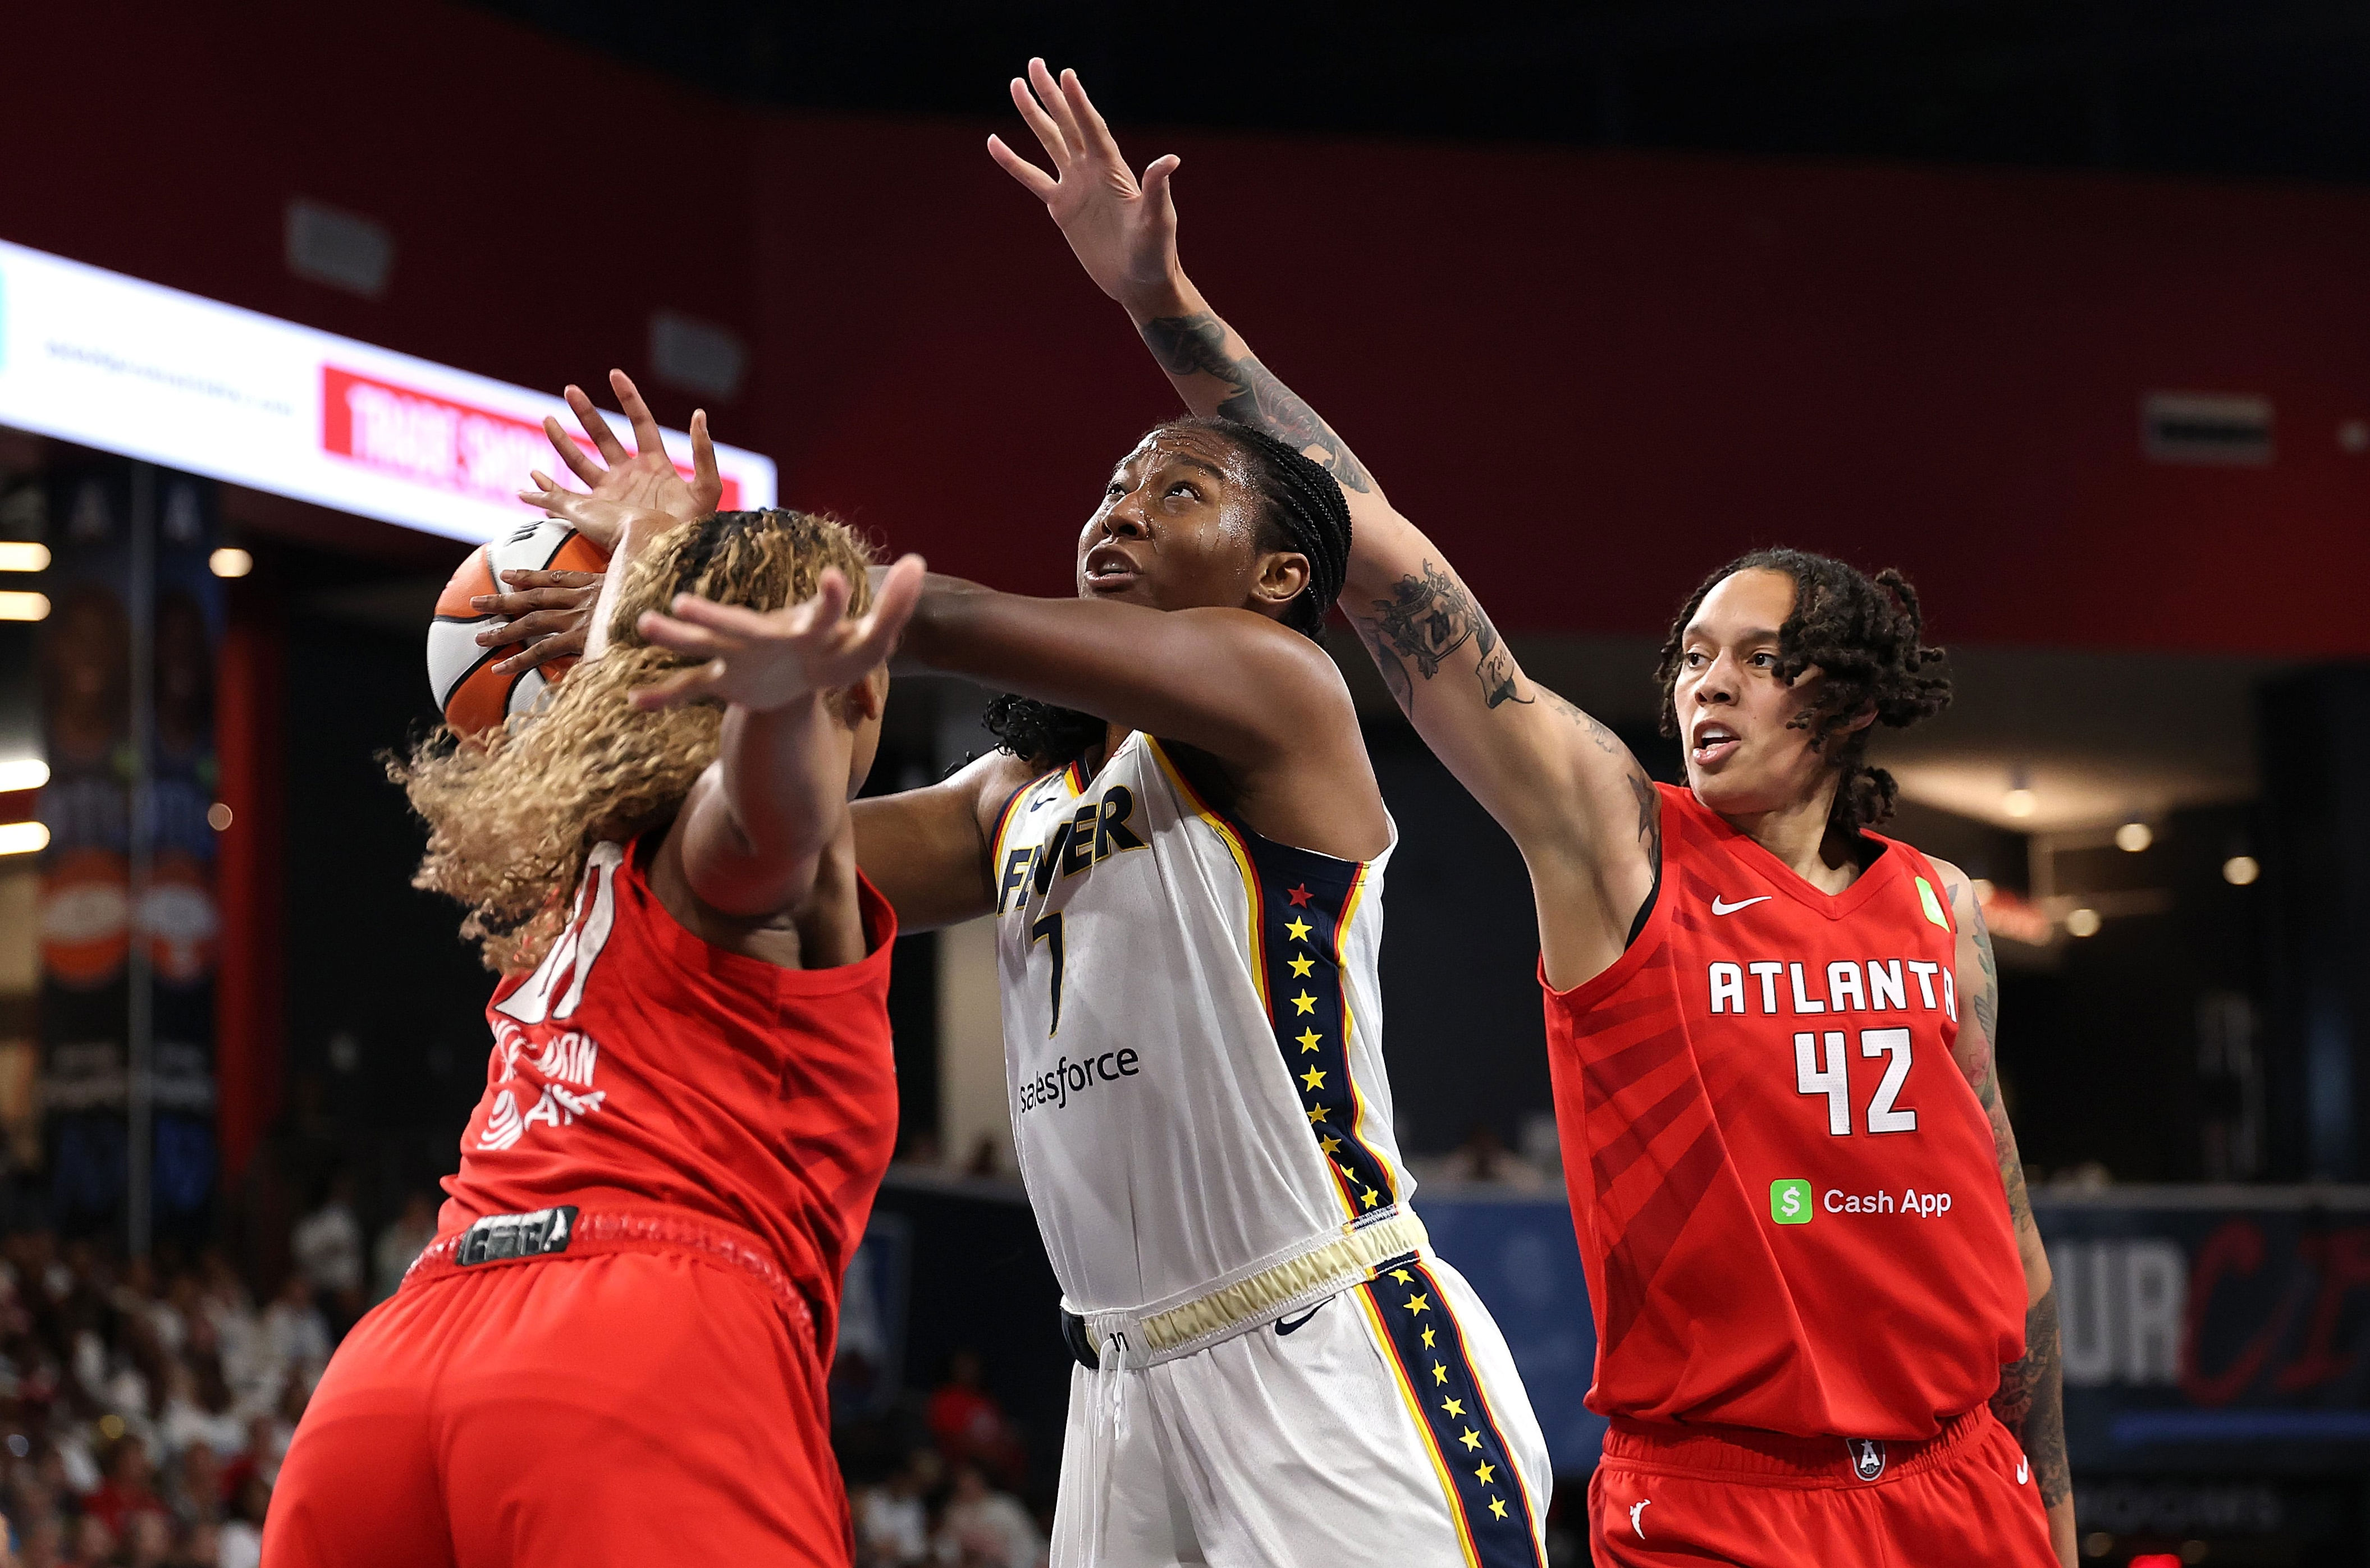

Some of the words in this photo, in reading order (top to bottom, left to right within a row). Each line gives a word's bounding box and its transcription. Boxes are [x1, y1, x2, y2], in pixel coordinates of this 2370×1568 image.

[996, 783, 1149, 918] FEVER
[1032, 909, 1065, 1039] 7
[1708, 959, 1958, 1024] ATLANTA
[1793, 1026, 1917, 1137] 42
[1824, 1189, 1895, 1214] Cash
[1900, 1188, 1952, 1218] App
[2051, 1237, 2188, 1386] UR
